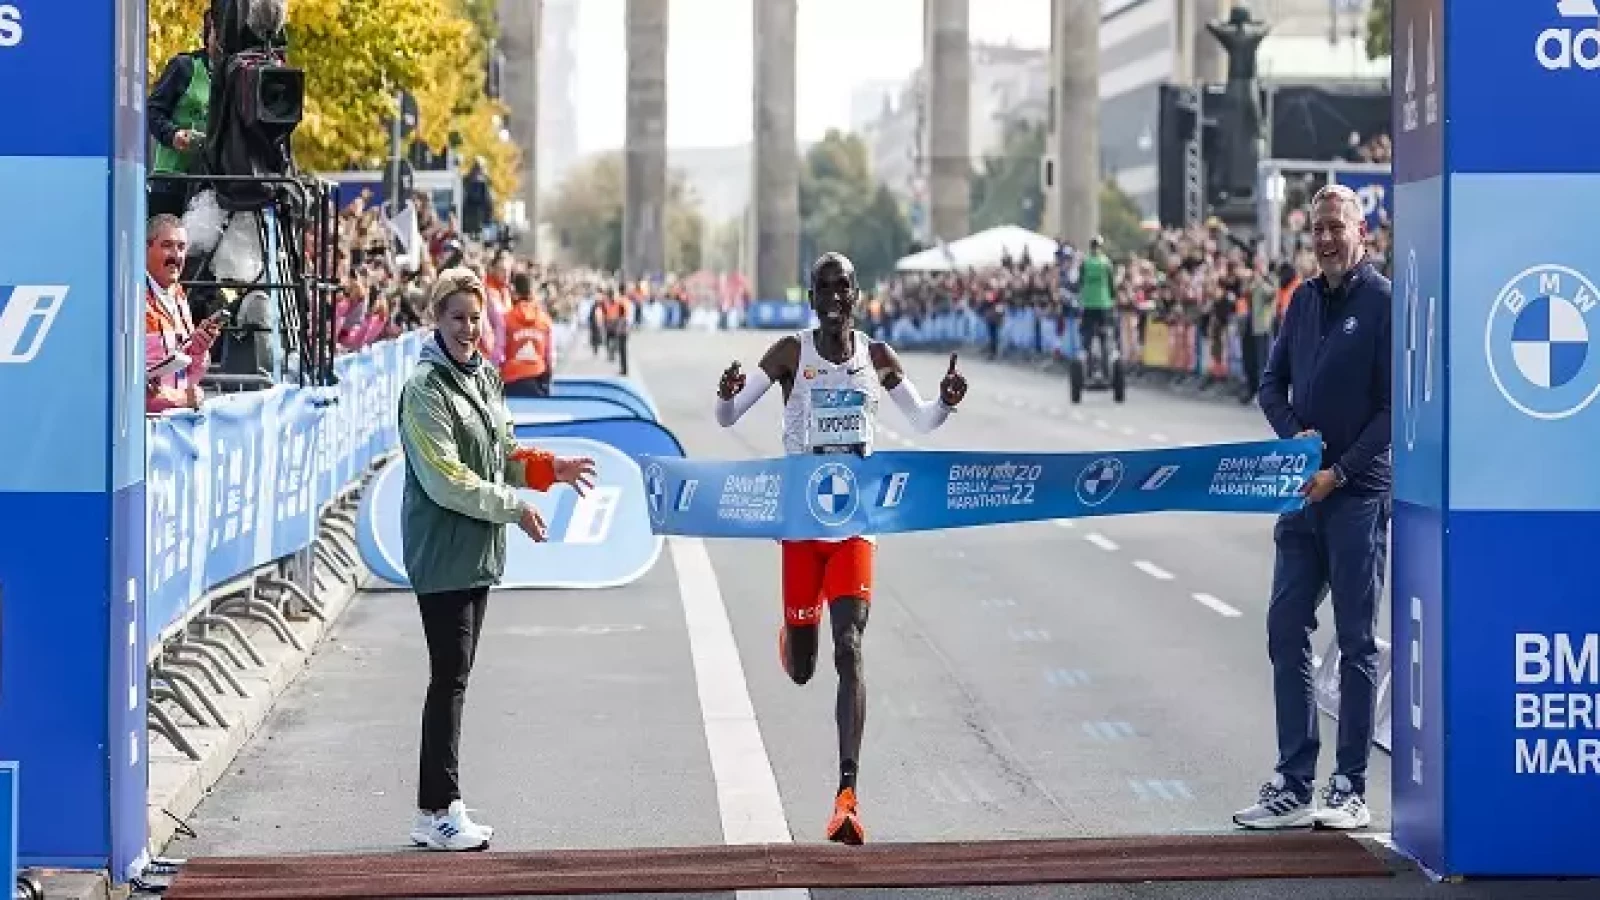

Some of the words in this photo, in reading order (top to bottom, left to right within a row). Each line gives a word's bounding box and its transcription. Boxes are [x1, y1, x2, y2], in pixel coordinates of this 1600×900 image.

[1503, 272, 1598, 315] BMW
[949, 464, 992, 481] BMW
[1015, 465, 1042, 481] 20
[1281, 453, 1308, 473] 20
[947, 480, 989, 495] BERLIN
[947, 493, 1012, 509] MARATHON
[1011, 483, 1035, 505] 22
[1278, 474, 1307, 498] 22
[1515, 633, 1599, 684] BM
